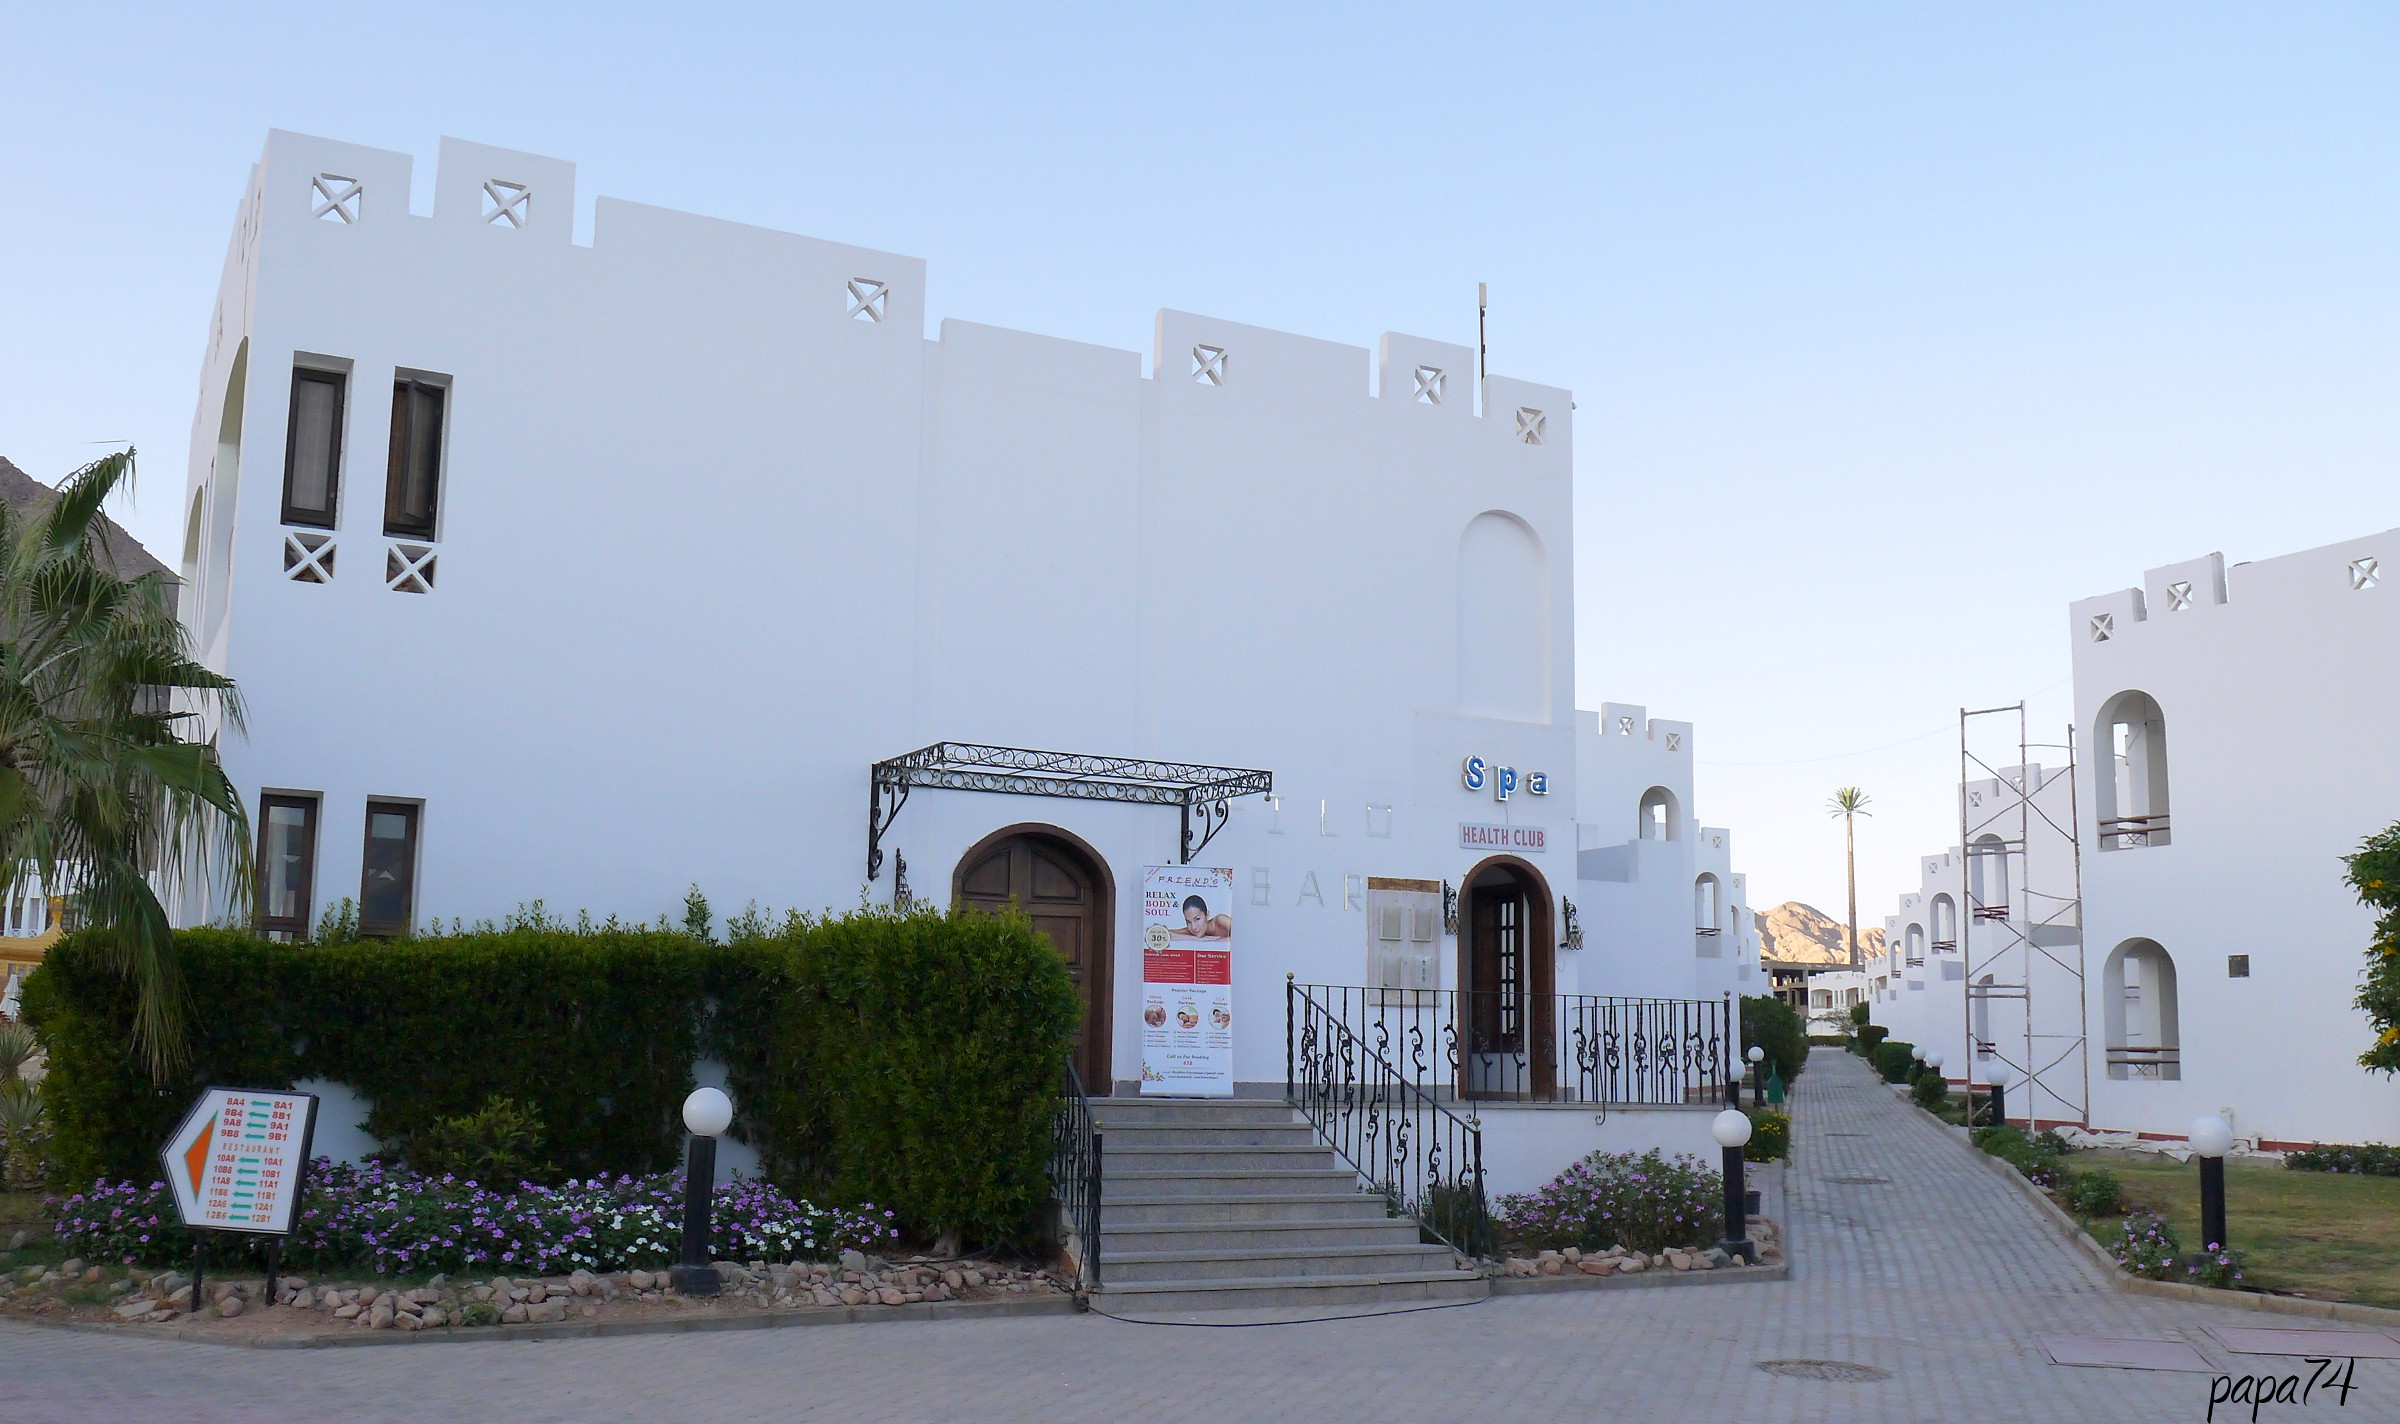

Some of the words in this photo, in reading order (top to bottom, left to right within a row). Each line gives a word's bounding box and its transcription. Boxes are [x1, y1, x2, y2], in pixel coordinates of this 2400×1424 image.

[1461, 755, 1550, 802] Spa
[1463, 826, 1508, 846] HEALTH
[1514, 829, 1544, 848] CLUB
[1251, 867, 1363, 912] BAR
[227, 1098, 245, 1106] 8A4
[224, 1109, 243, 1117] 8B4
[272, 1112, 291, 1120] 8B1
[270, 1122, 289, 1130] 9A1
[268, 1133, 287, 1141] 9B1
[222, 1143, 280, 1154] RESTAURANT
[264, 1158, 282, 1166] 10A1
[262, 1169, 280, 1178] 10B1
[259, 1180, 278, 1188] 11A1
[257, 1191, 275, 1200] 11B1
[254, 1203, 273, 1211] 12A1
[252, 1215, 270, 1223] 12B1
